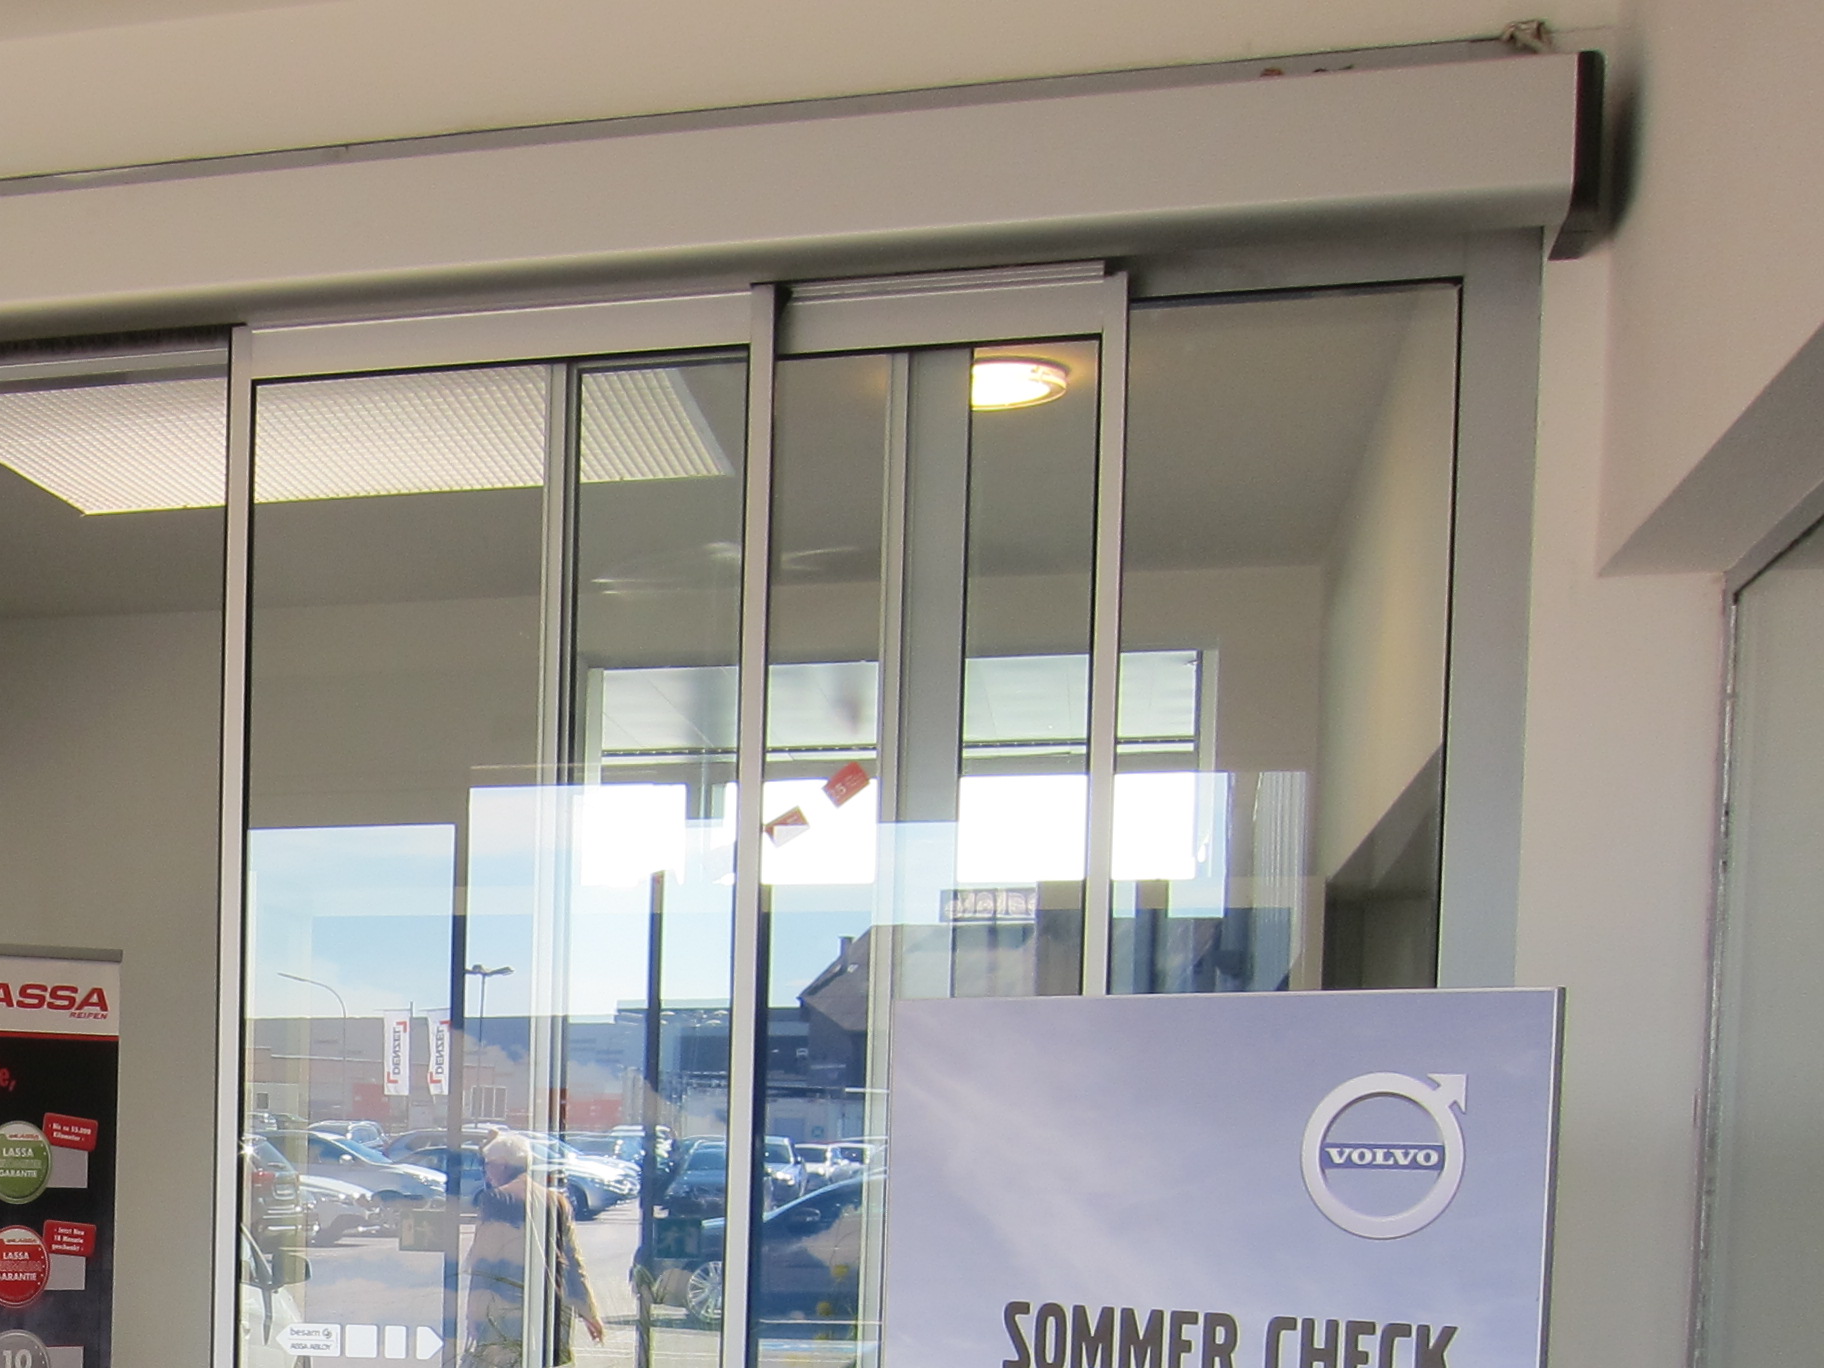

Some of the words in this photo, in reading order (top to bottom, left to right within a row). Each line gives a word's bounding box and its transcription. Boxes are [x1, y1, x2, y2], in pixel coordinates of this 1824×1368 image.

[69, 1011, 108, 1020] REIFEN
[2, 1147, 35, 1157] LASSA
[1325, 1147, 1439, 1167] VOLVO
[2, 1251, 30, 1260] LASSA
[290, 1327, 321, 1336] besam
